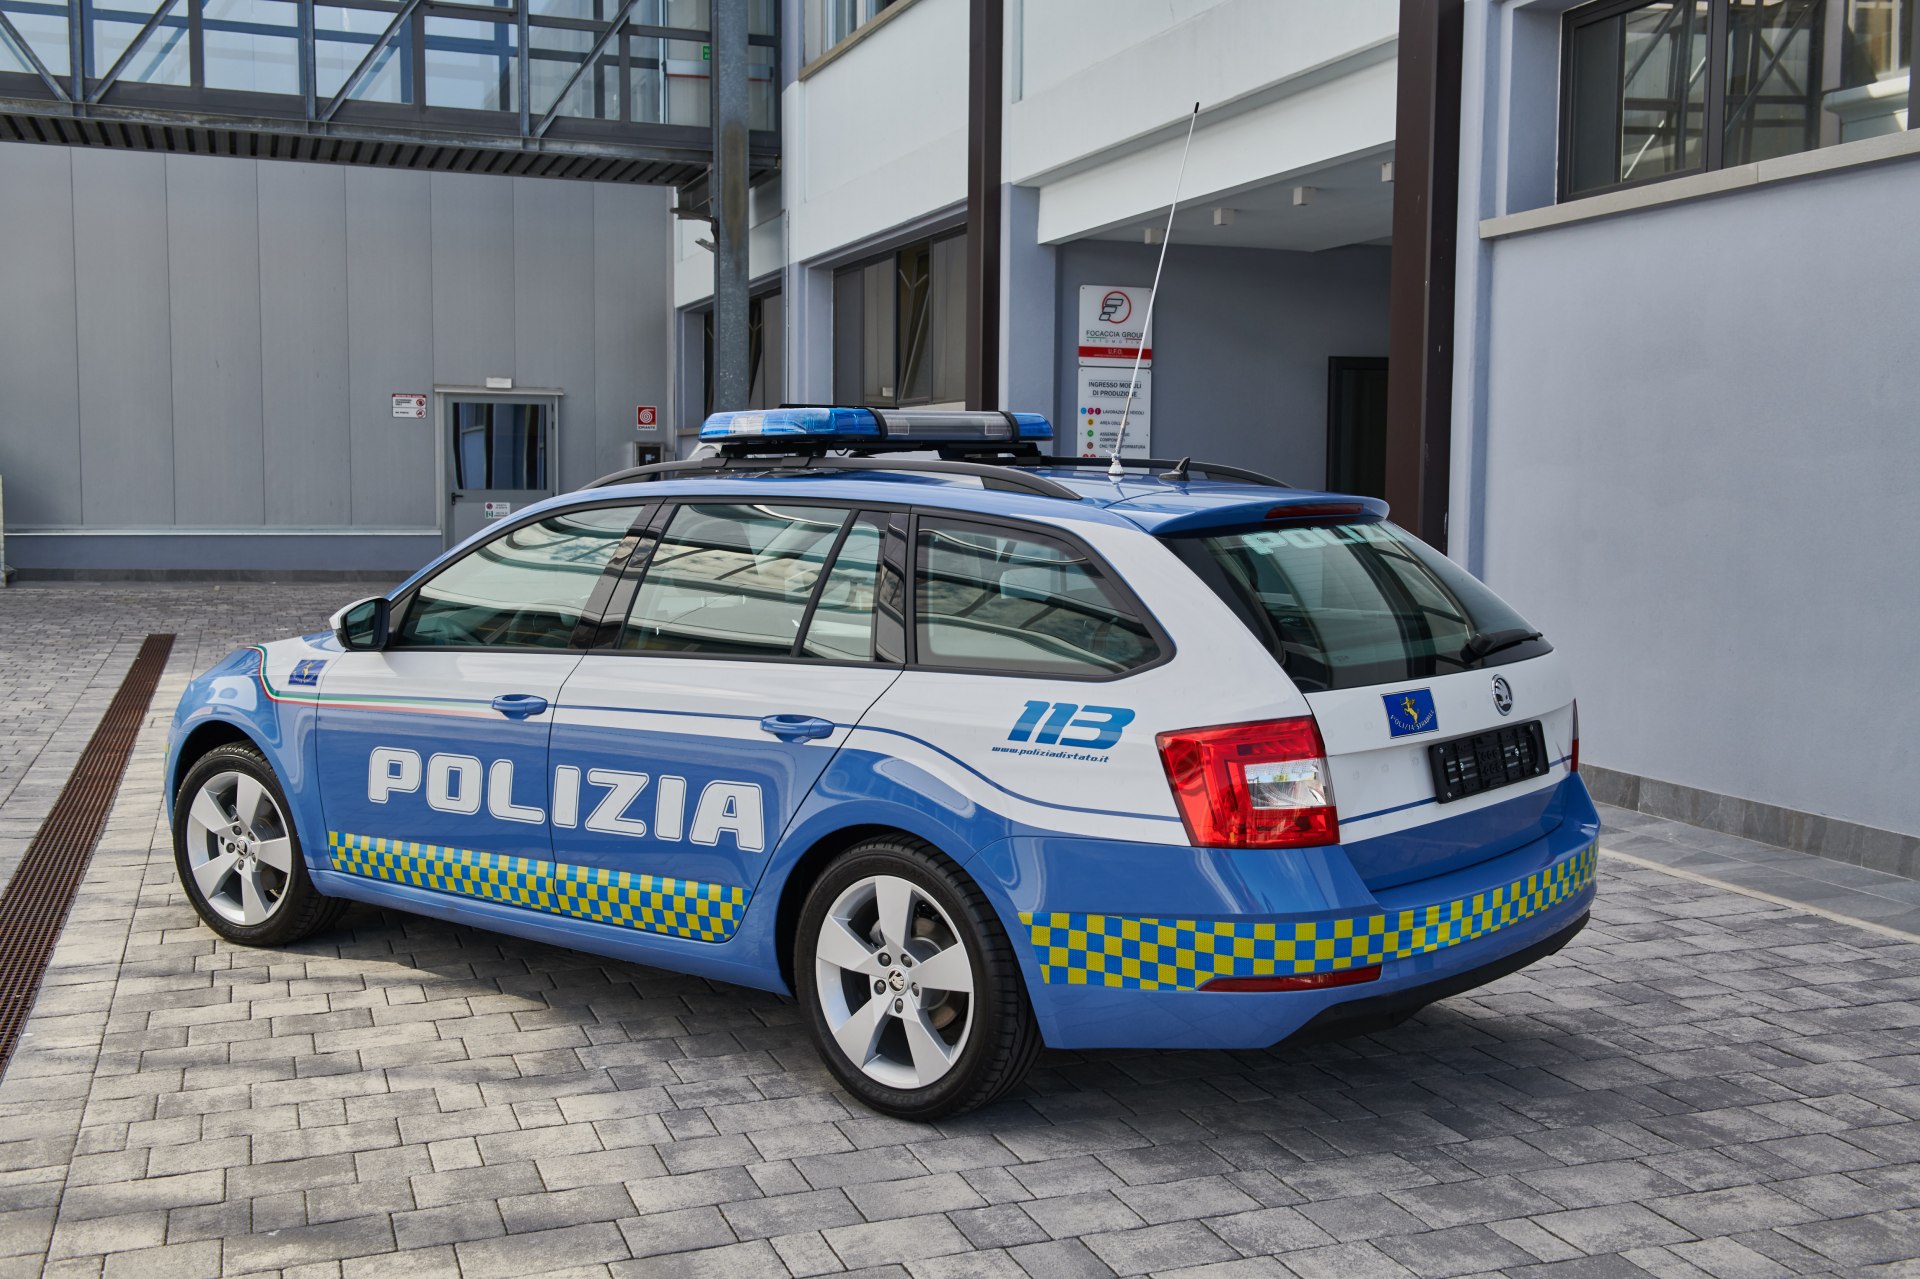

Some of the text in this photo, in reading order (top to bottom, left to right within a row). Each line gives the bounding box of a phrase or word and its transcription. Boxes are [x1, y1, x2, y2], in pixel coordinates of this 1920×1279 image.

[1086, 329, 1120, 338] FOCACCIA
[1100, 390, 1137, 398] PRODUZIOE
[1008, 700, 1136, 750] 113
[1390, 714, 1415, 731] POLIZIA
[991, 746, 1110, 763] www.poliziadistato.it
[368, 746, 765, 853] POLIZIA
